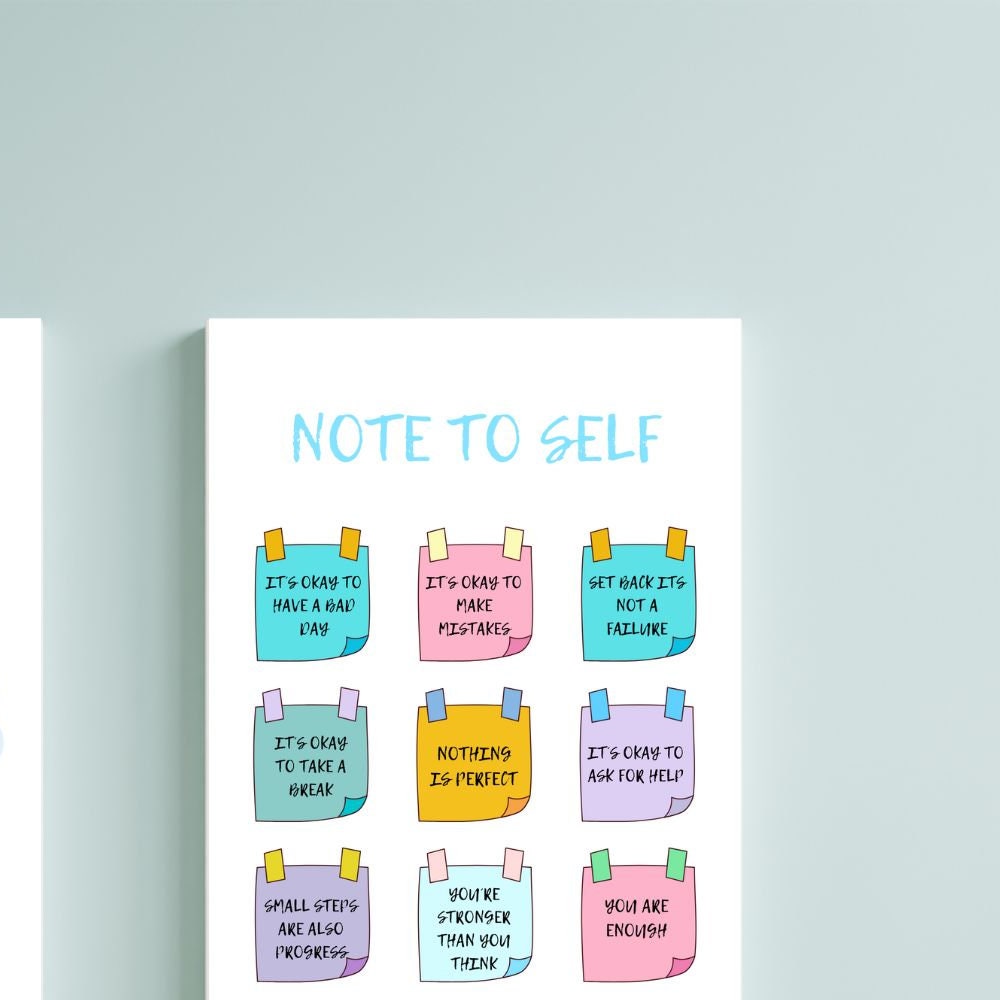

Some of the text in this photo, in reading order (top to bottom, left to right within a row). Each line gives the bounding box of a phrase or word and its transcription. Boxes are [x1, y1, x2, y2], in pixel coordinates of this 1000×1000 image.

[293, 412, 662, 464] NOTE TO SELF
[265, 574, 362, 591] IT'S OKAY TO
[425, 574, 522, 591] IT'S OKAY TO
[588, 574, 686, 591] SET BACK ITS
[273, 598, 356, 614] HAVE A BAD
[456, 597, 493, 614] MAKE
[616, 598, 658, 613] NOT A
[299, 621, 329, 637] DAY
[438, 621, 512, 637] MISTAKES
[607, 621, 669, 637] FAILURE
[274, 735, 349, 752] IT'S OKAY
[437, 745, 512, 763] NOTHING
[587, 745, 684, 761] IT'S OKAY TO
[274, 758, 346, 774] TO TAKE A
[429, 770, 519, 788] IS PERFECT
[587, 768, 684, 784] ASK FOR HELP
[288, 781, 334, 798] BREAK
[448, 887, 500, 903] YOU'RE
[264, 898, 360, 914] SMALL STEPS
[604, 898, 669, 915] YOU ARE
[437, 909, 511, 926] STRONGER
[278, 921, 344, 937] ARE ALSO
[606, 922, 667, 939] ENOUGH
[437, 933, 511, 949] THAN YOU
[275, 944, 350, 959] PROGRESS
[450, 956, 498, 971] THINK
